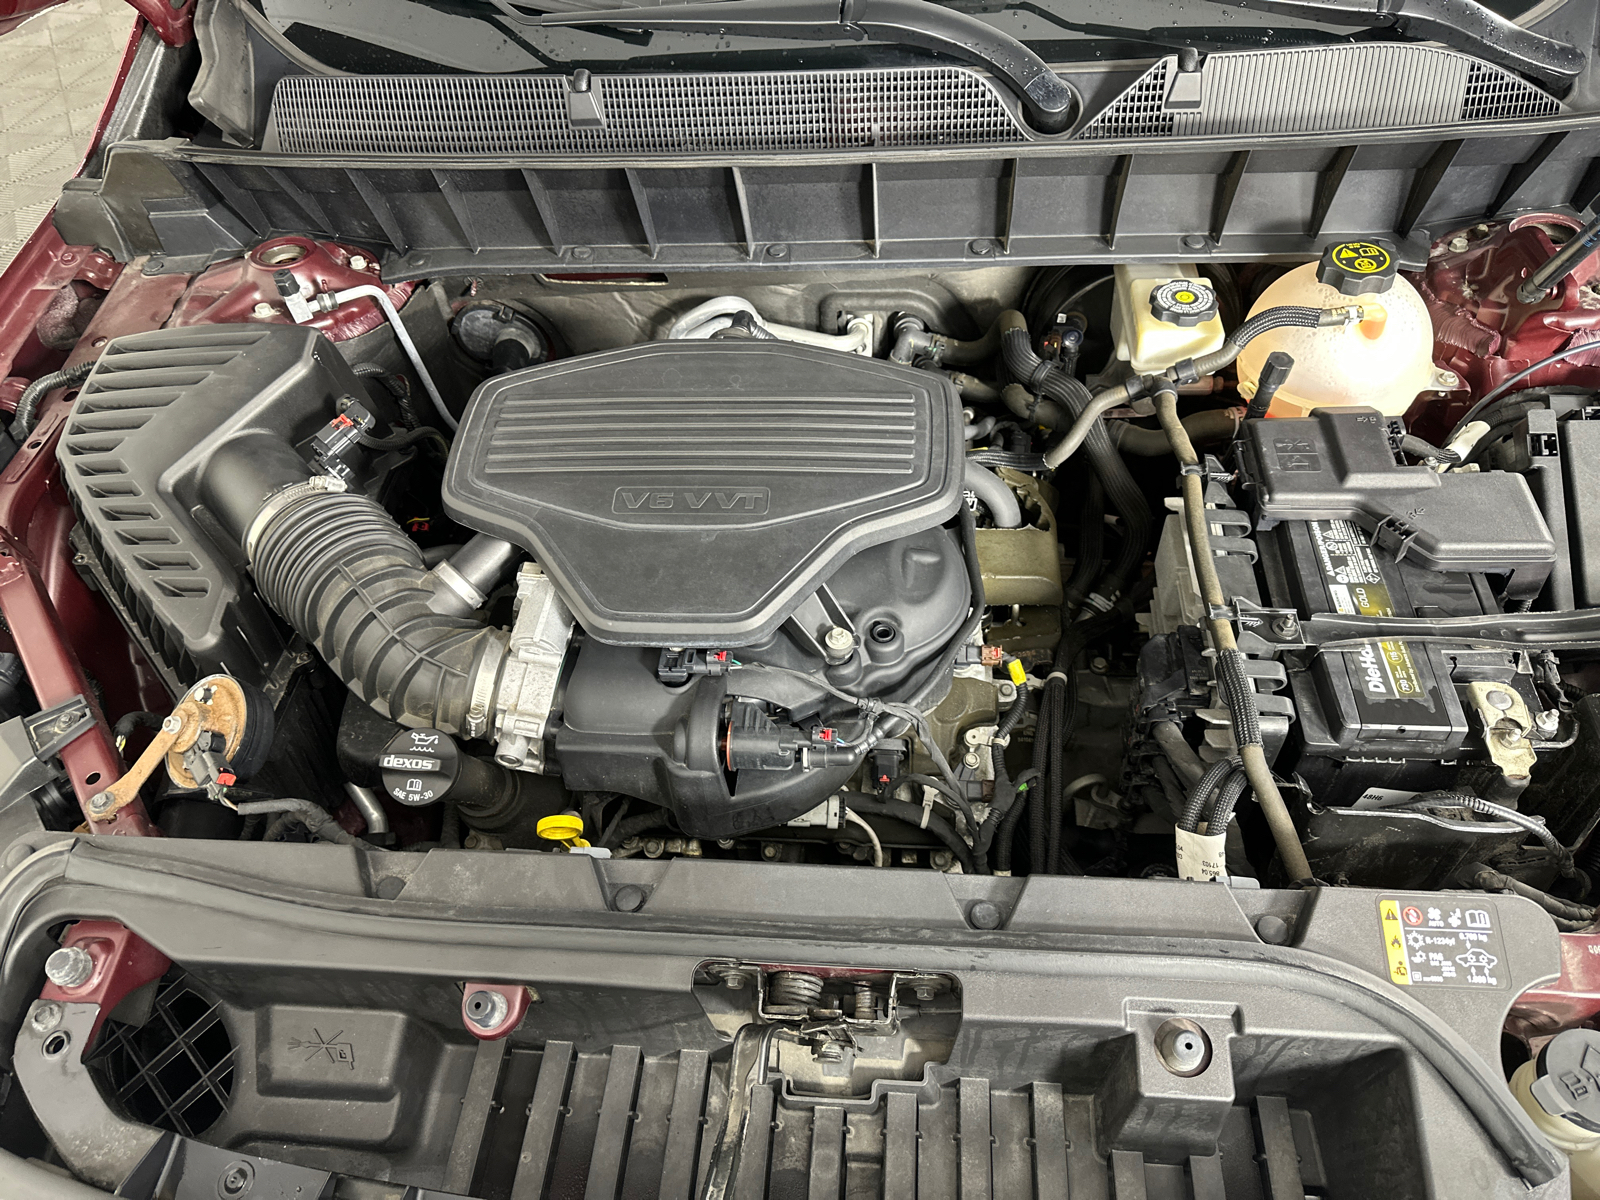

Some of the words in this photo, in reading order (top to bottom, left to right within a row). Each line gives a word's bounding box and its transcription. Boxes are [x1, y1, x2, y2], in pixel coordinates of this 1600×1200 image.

[621, 492, 674, 509] V6
[683, 492, 764, 509] VVT
[1356, 587, 1370, 608] GOLD
[1400, 679, 1411, 691] 730
[383, 755, 433, 770] dexos
[393, 787, 407, 800] SAE
[408, 790, 434, 802] 5W-30
[1362, 793, 1384, 801] 48H6
[1425, 936, 1456, 947] R-1234yf
